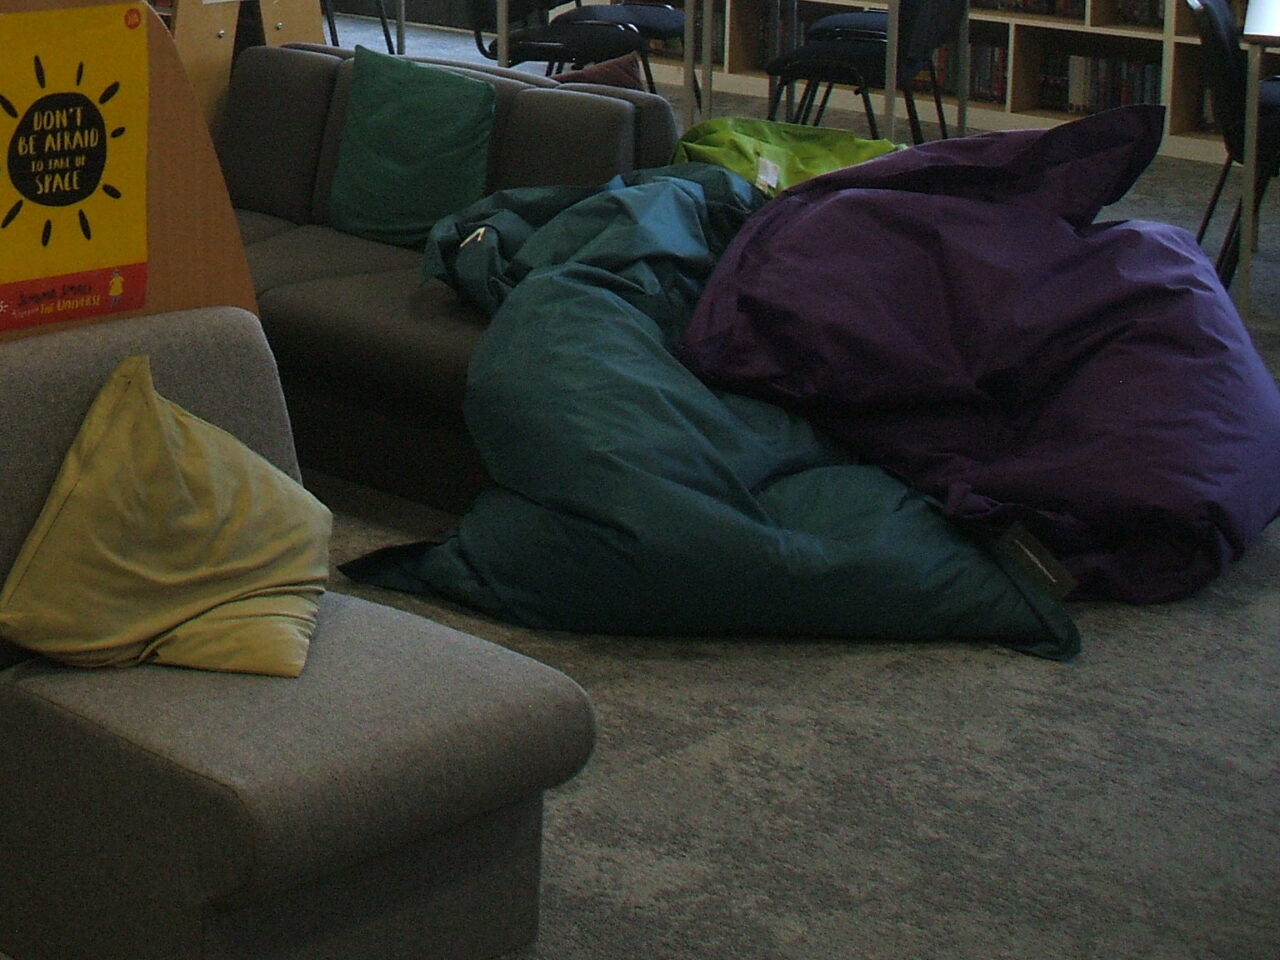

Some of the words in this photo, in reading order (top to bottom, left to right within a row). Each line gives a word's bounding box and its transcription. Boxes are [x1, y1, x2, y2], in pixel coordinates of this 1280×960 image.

[33, 106, 84, 131] DON'T
[17, 134, 37, 156] BE
[45, 127, 99, 153] AFRAID
[31, 160, 44, 172] TO
[48, 156, 70, 170] TAKE
[75, 154, 86, 168] UP
[35, 170, 81, 195] SPACE
